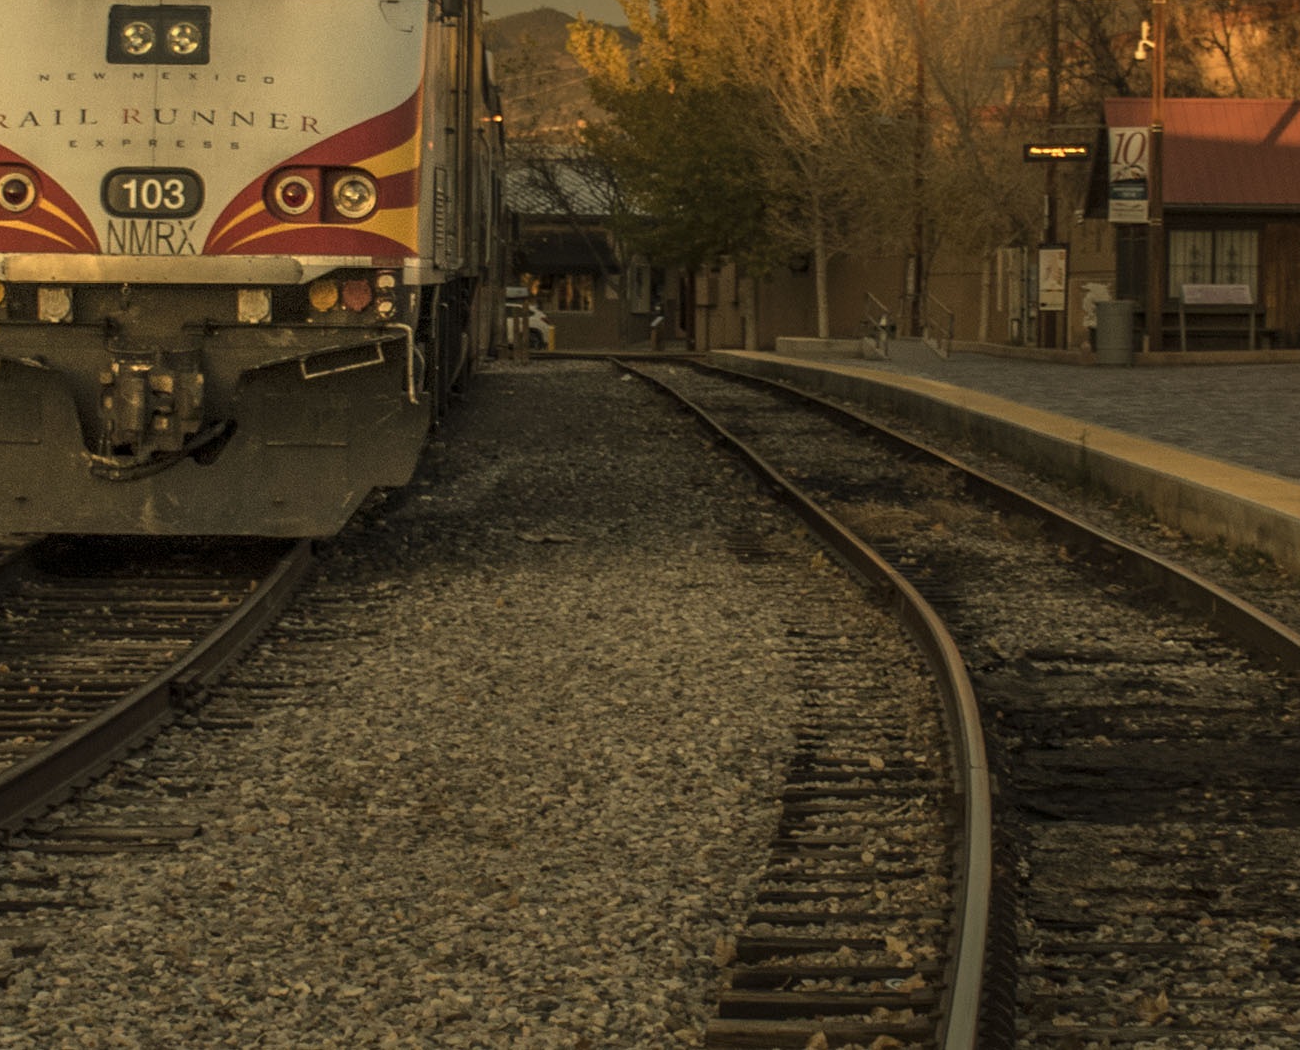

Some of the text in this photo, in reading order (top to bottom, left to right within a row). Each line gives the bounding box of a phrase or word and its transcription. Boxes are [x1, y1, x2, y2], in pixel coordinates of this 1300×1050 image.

[39, 72, 275, 84] NEW MEXICO
[122, 108, 321, 134] RUNNER
[69, 139, 240, 150] EXPRESS
[122, 178, 186, 210] 103
[107, 220, 197, 255] NMRX
